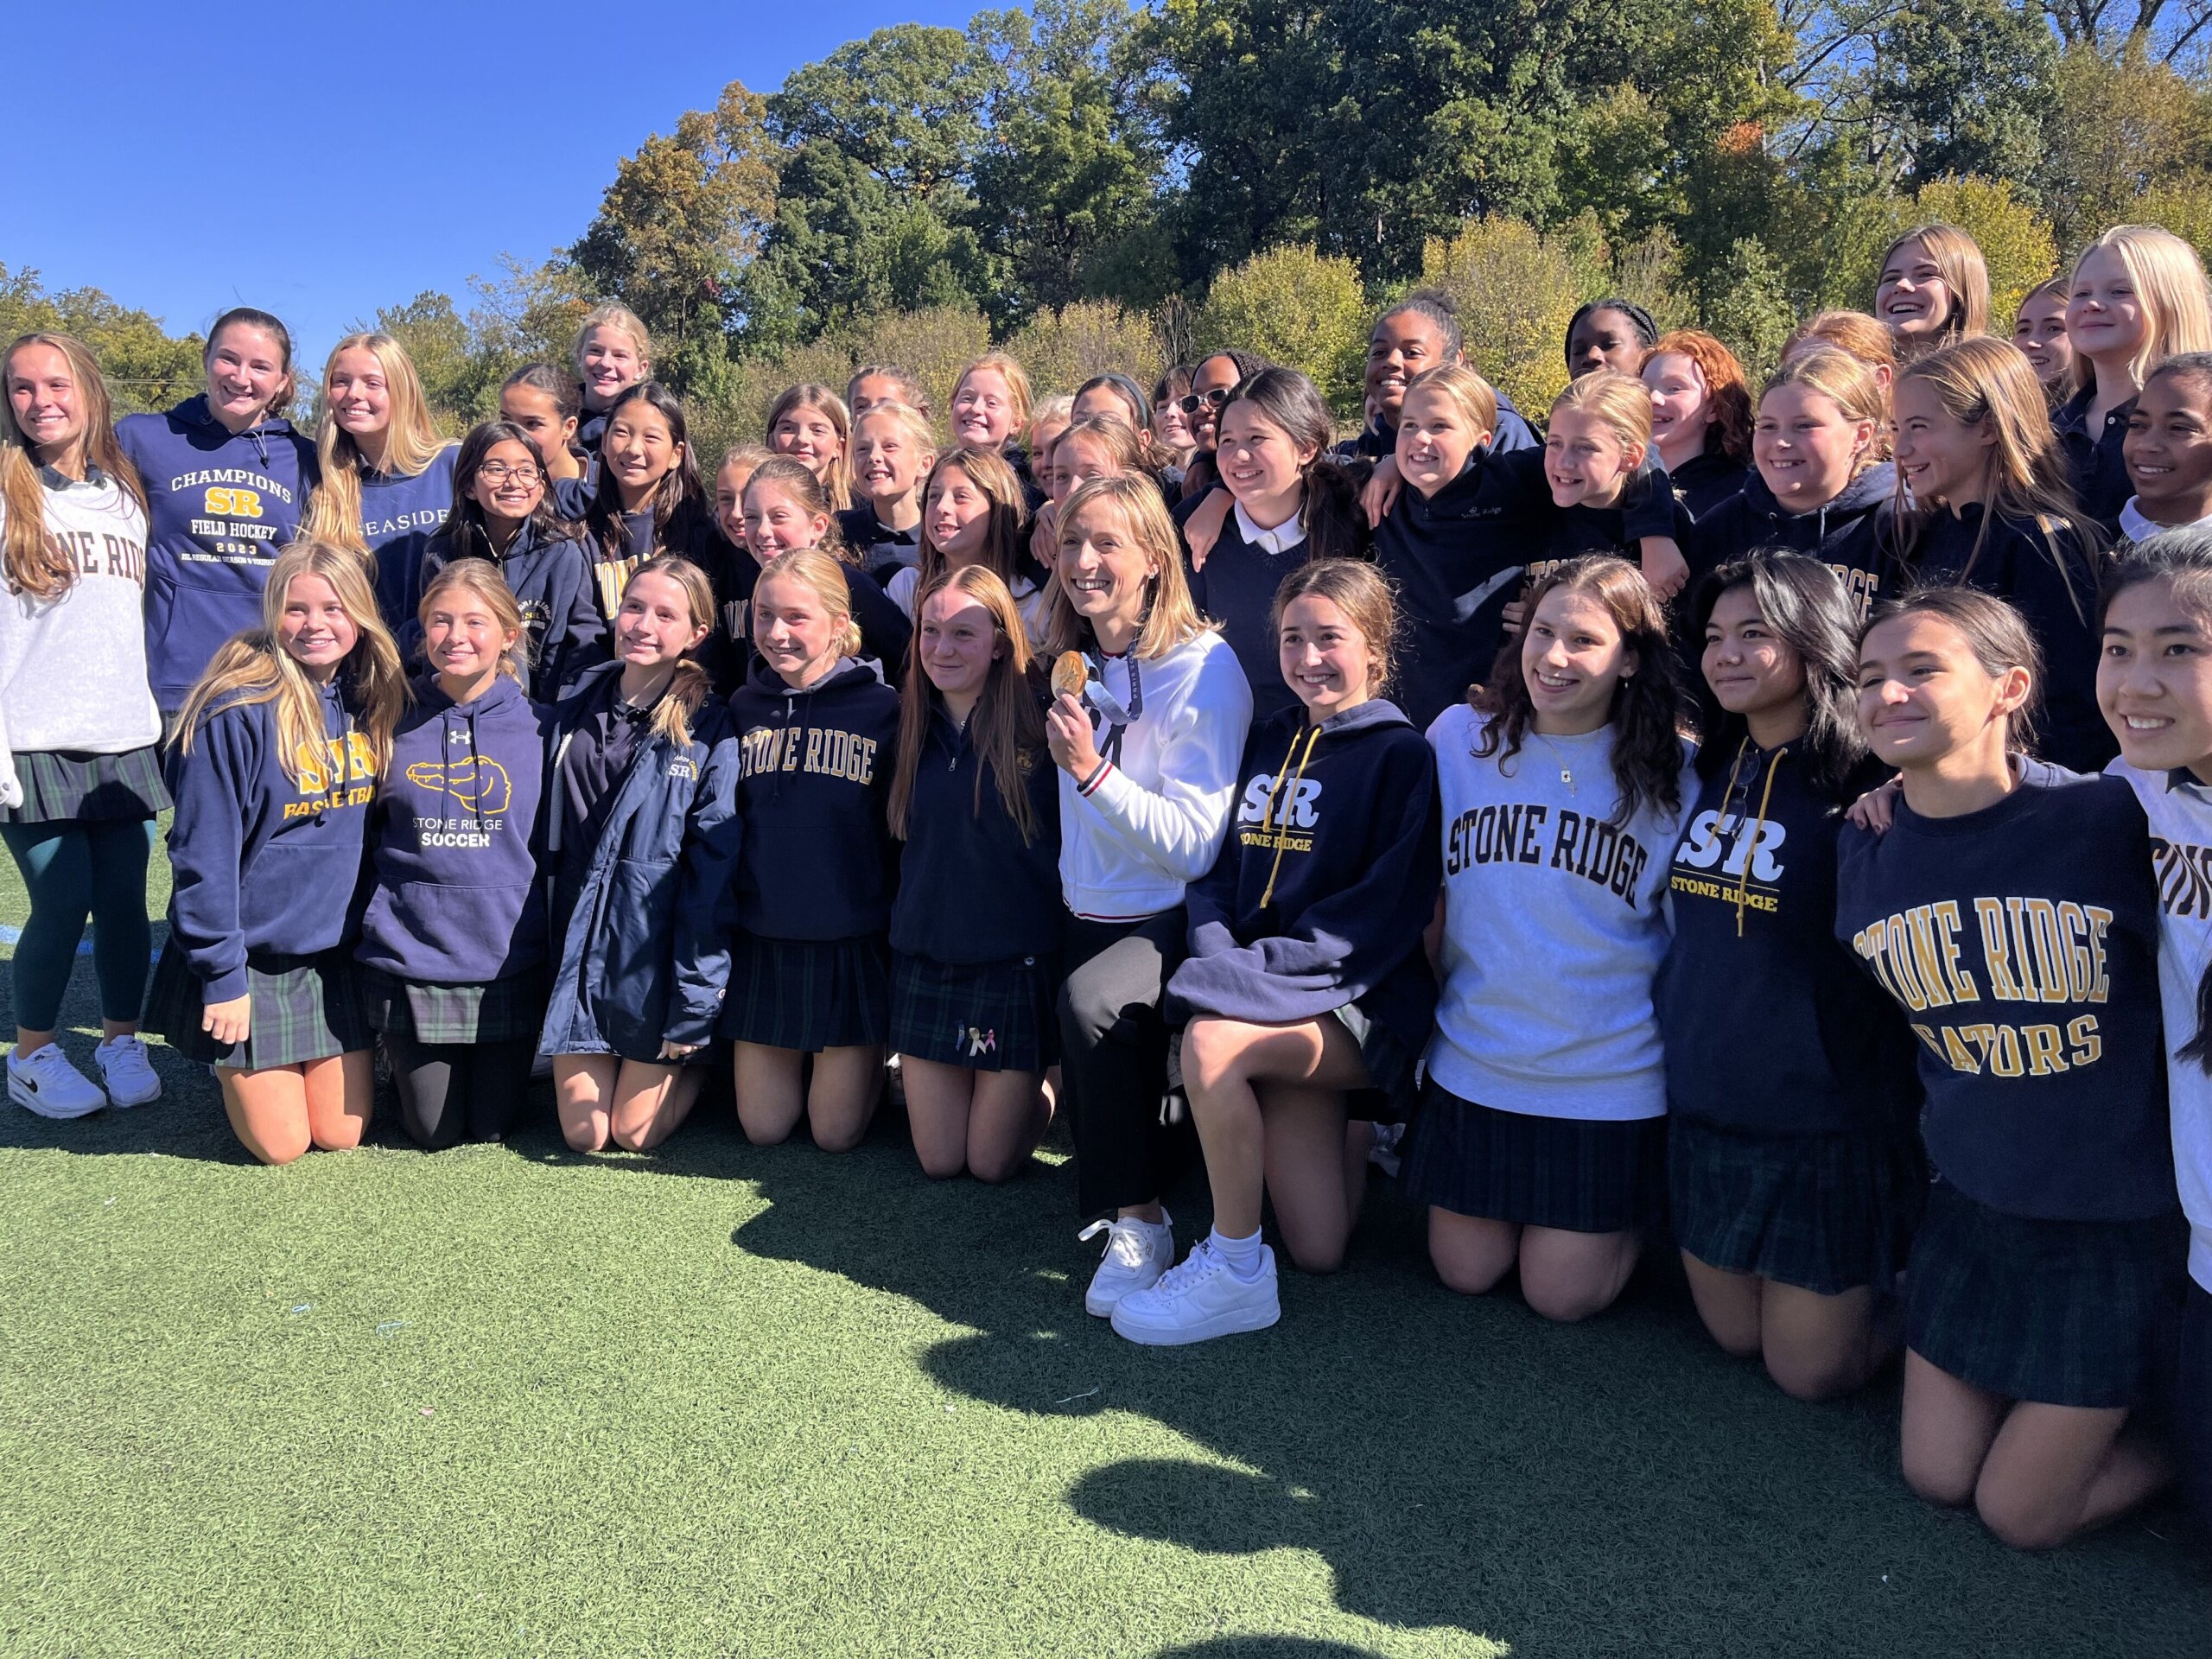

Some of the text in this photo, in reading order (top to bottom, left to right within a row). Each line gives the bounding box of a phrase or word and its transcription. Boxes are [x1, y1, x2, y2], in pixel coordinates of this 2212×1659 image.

[171, 469, 291, 505] CHAMPIONS
[205, 486, 264, 518] SR
[190, 519, 277, 540] FIELD HOCKEY
[216, 542, 257, 554] 2023
[669, 764, 690, 778] SR
[804, 728, 877, 785] RIDGE
[1237, 773, 1322, 828] SR
[413, 817, 503, 830] STONE RIDGE
[421, 832, 490, 847] SOCCER
[1446, 804, 1648, 911] STONE RIDGE
[1675, 810, 1786, 881] SR
[1671, 875, 1778, 912] STONE RIDGE
[1974, 897, 2113, 1003] RIDGE
